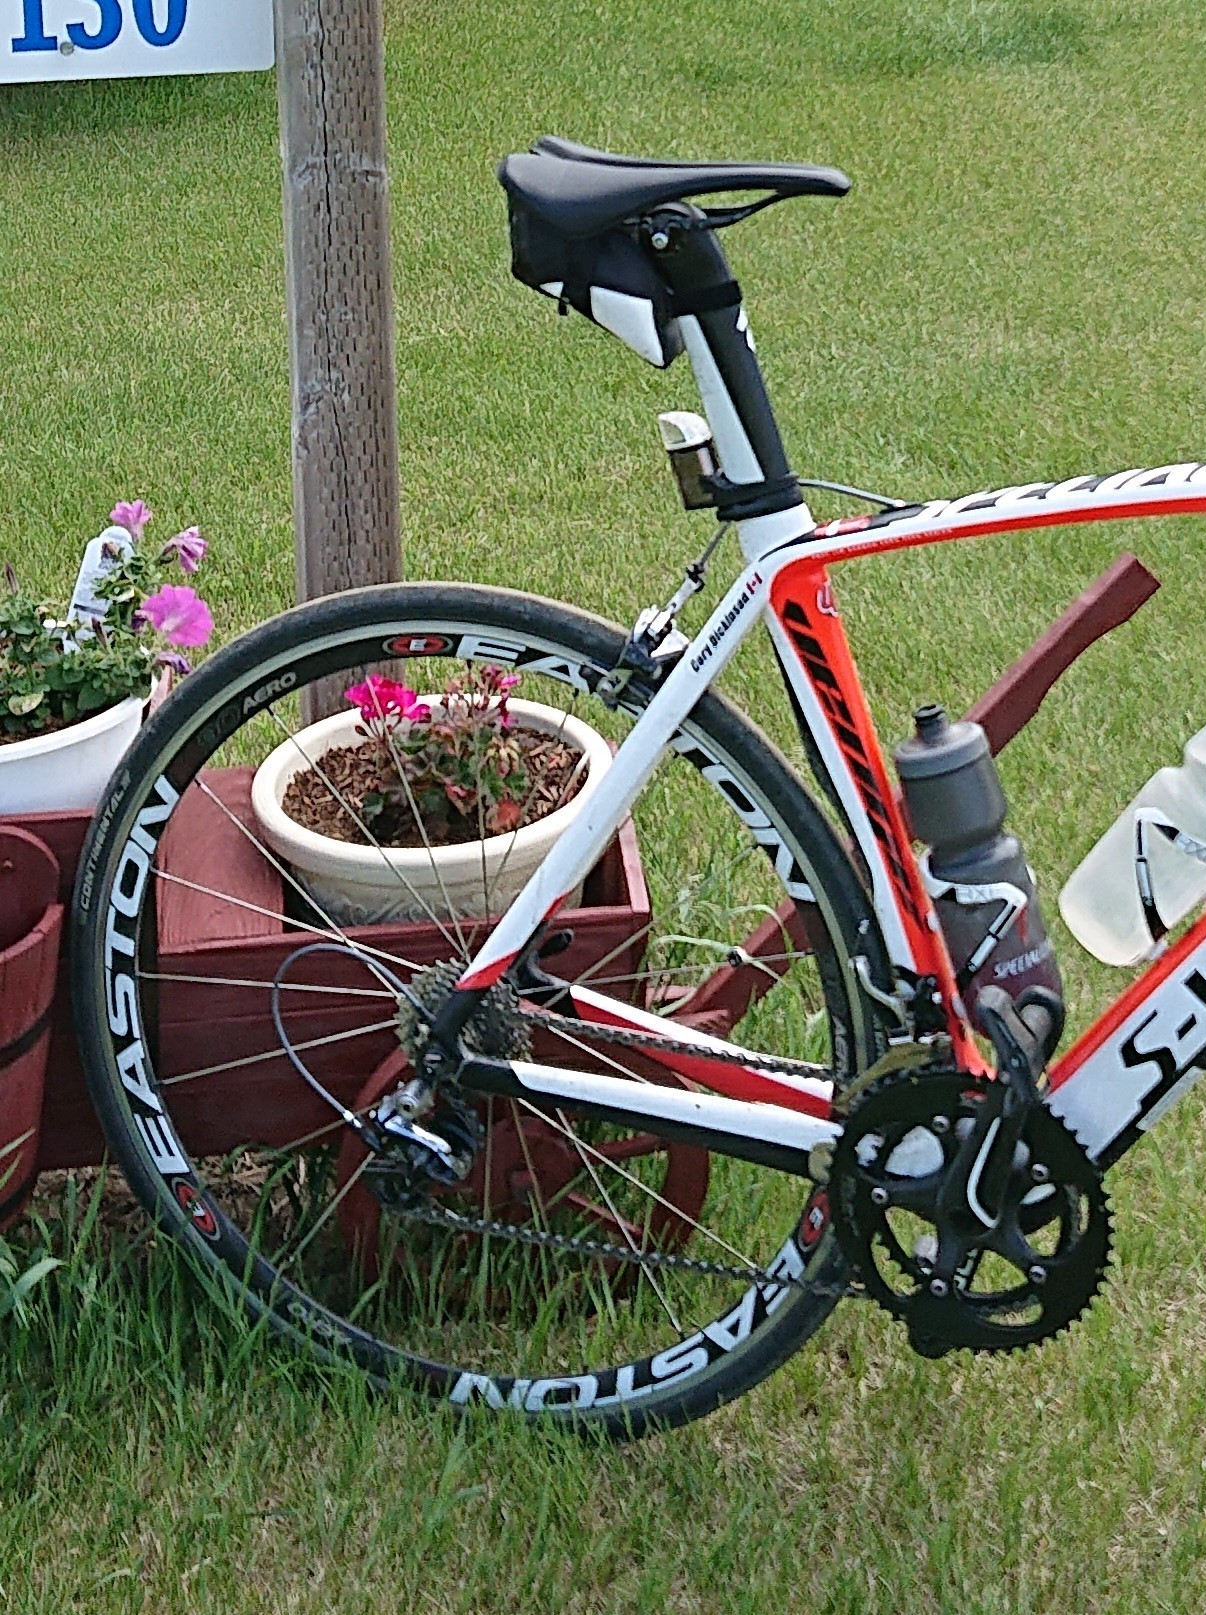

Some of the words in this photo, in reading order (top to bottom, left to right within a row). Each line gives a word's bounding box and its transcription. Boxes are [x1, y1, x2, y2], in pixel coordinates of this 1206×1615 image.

[242, 671, 298, 715] AERO
[79, 788, 126, 911] CONTINENTAL
[104, 773, 190, 1174] EASTON
[450, 1238, 806, 1412] EASTON
